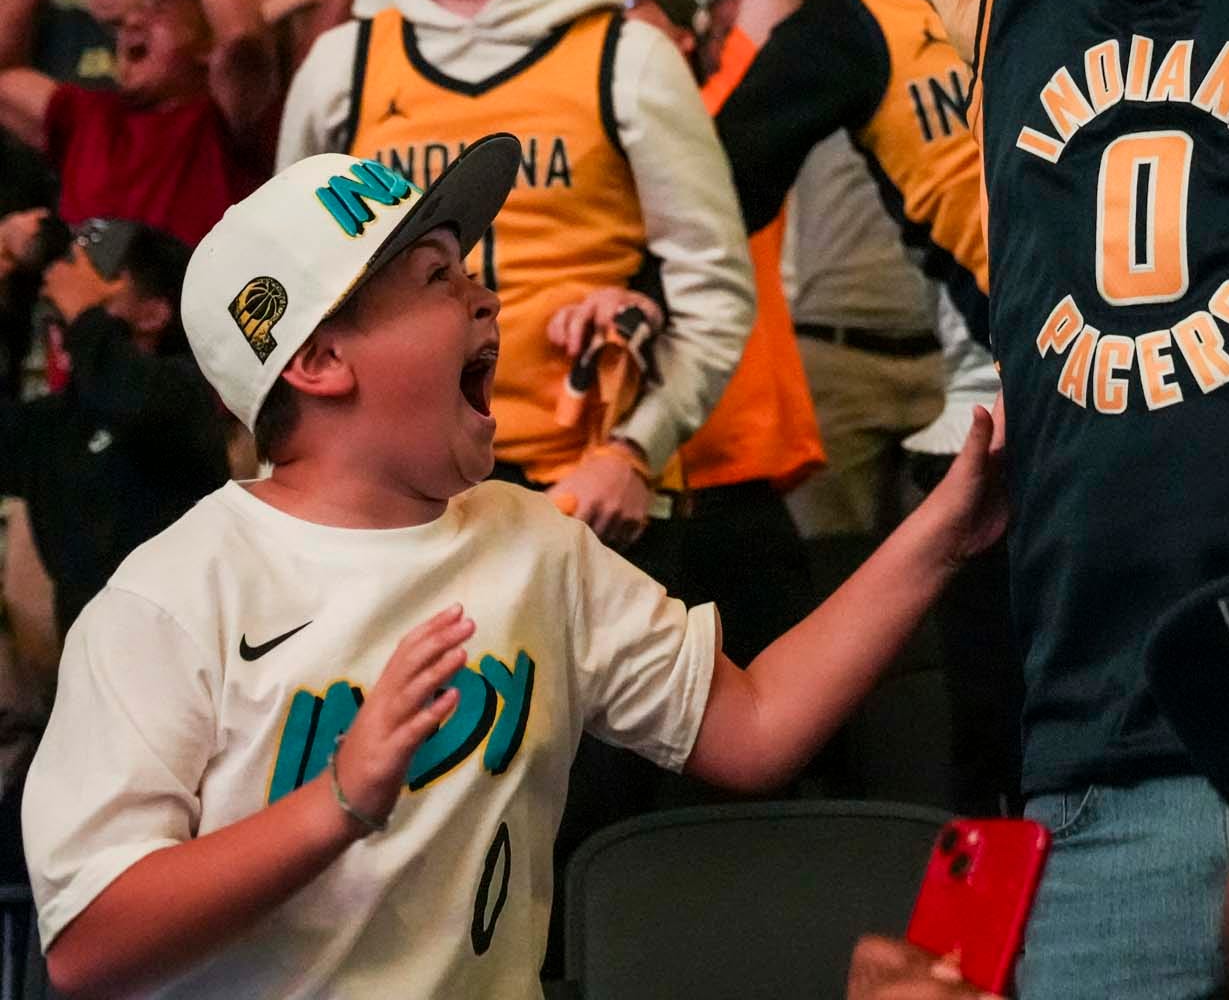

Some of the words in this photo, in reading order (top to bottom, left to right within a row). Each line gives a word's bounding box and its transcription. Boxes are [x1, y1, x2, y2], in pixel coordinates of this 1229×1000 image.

[315, 158, 424, 238] IND
[1096, 130, 1194, 307] 0
[471, 822, 511, 956] 0
